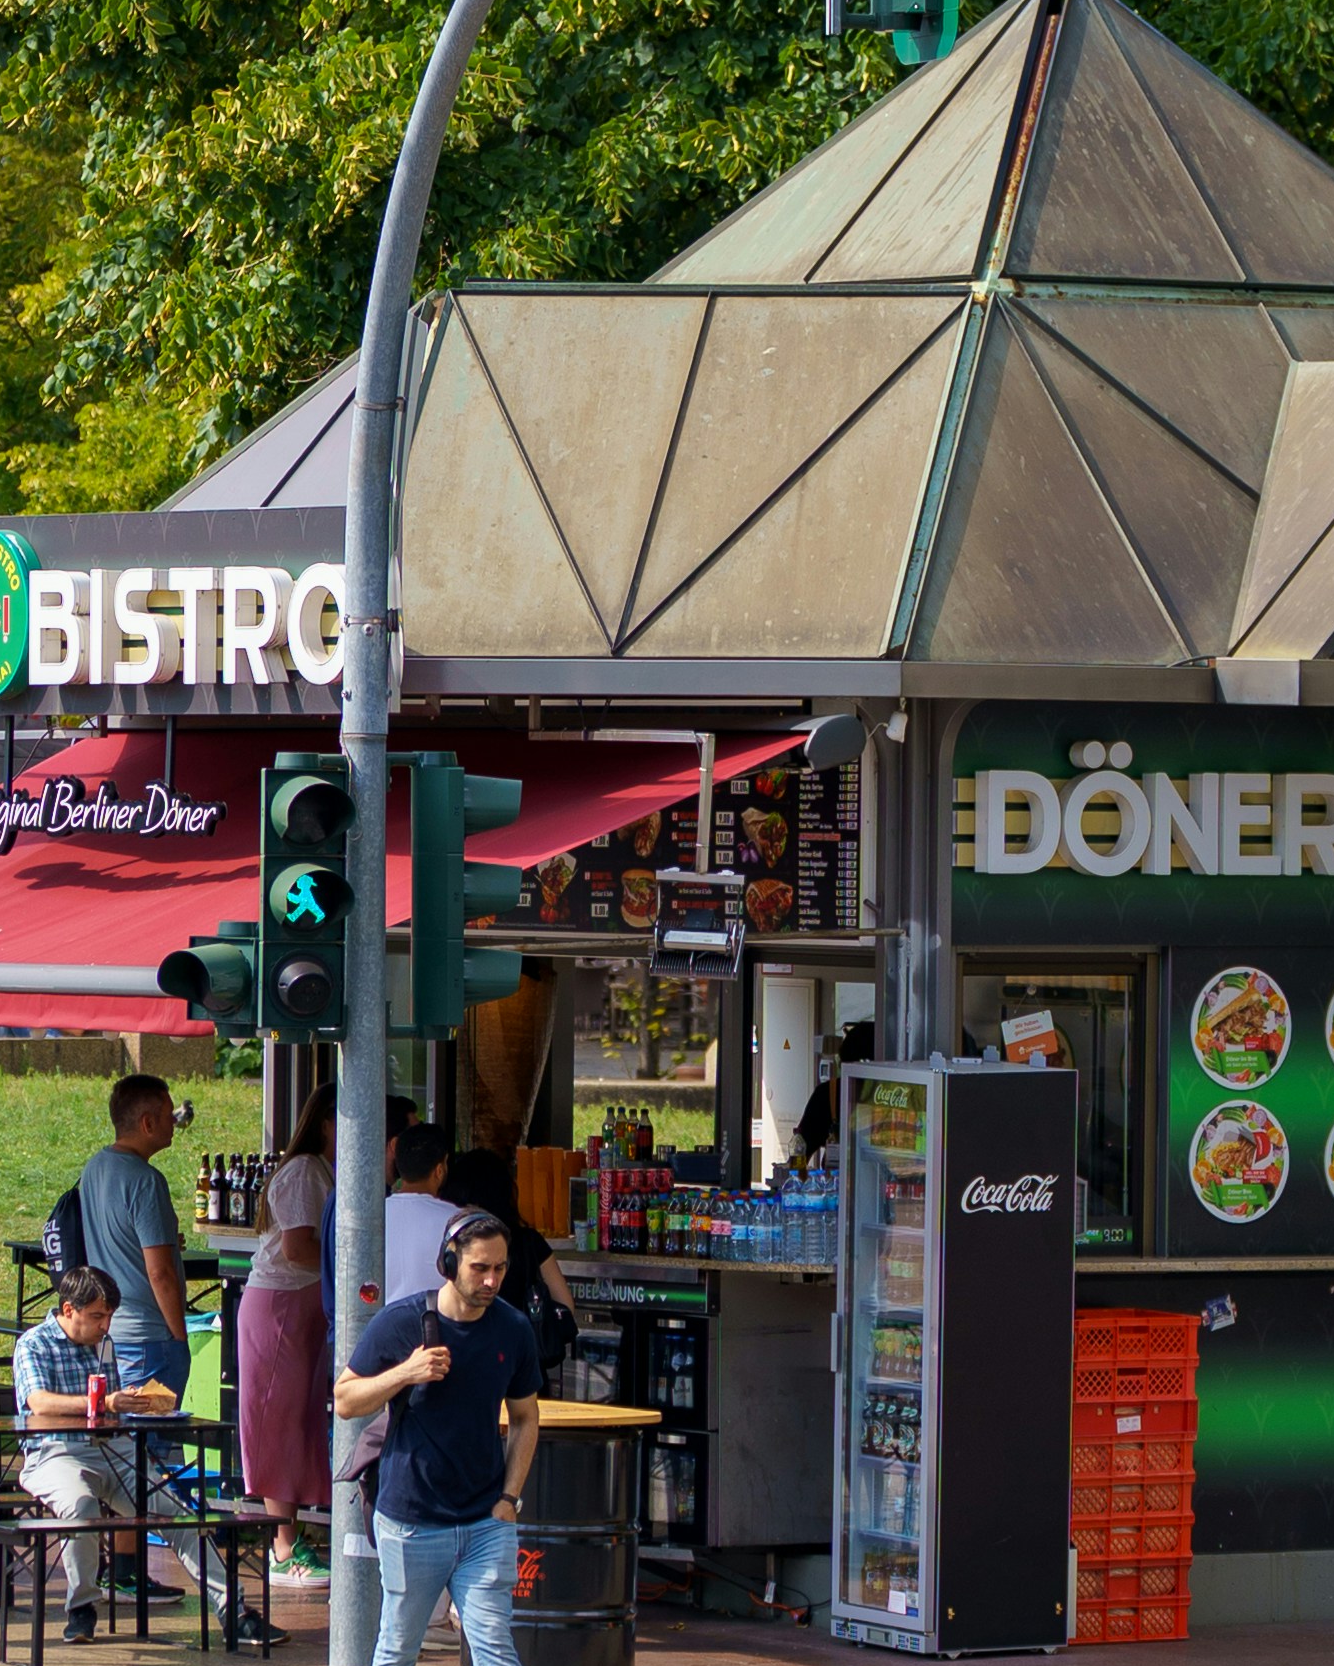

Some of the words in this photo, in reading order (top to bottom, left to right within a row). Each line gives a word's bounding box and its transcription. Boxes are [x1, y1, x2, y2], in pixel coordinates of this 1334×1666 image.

[28, 562, 346, 686] BISTRO
[46, 779, 143, 833] Berliner
[139, 783, 217, 834] Döner
[961, 1174, 1059, 1214] Coca-Cola
